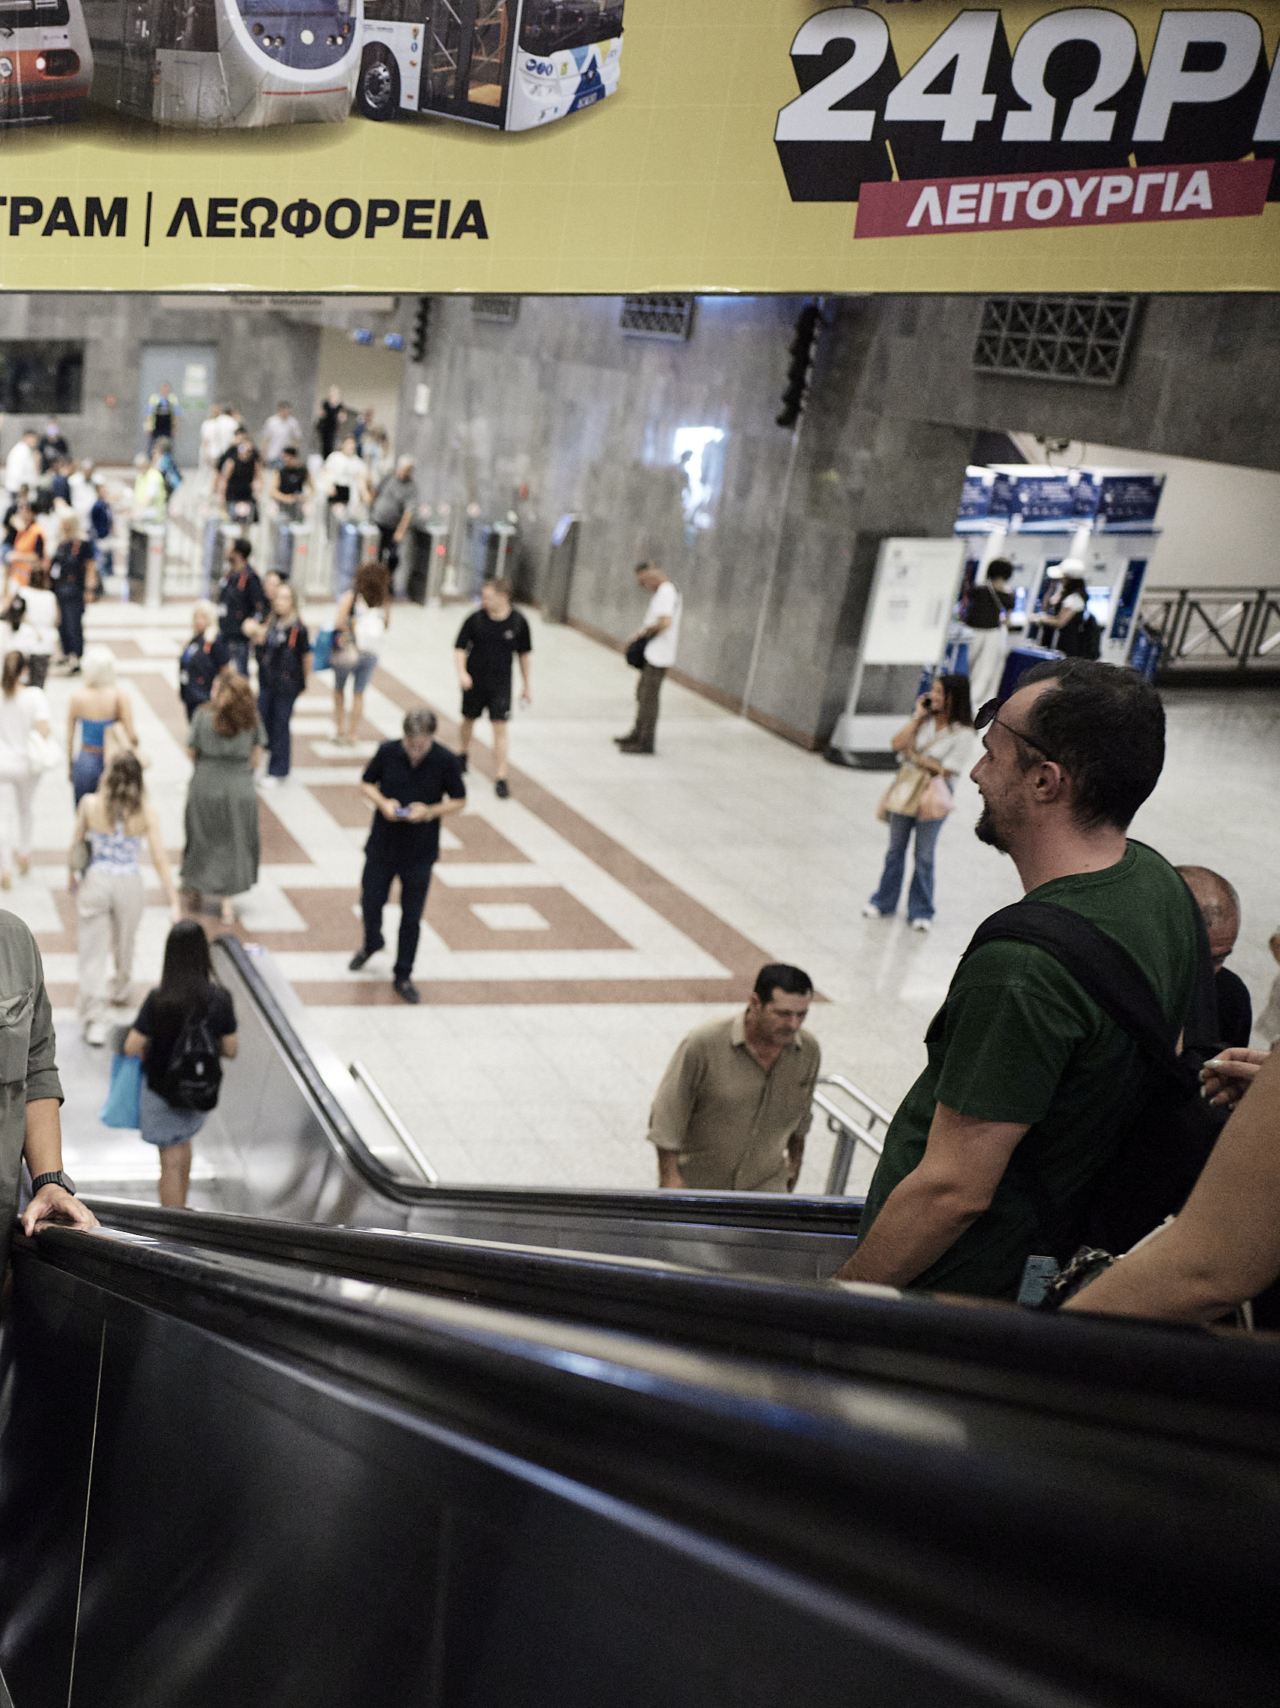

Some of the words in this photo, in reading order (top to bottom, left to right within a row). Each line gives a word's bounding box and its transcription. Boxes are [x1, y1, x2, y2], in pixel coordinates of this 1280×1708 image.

[774, 6, 1280, 142] 24ΩΡ
[166, 197, 489, 240] ΛΕΩΦΟΡΕΙΑ
[906, 170, 1213, 228] ΛΕΙΤΟΥΡΓΙΑ
